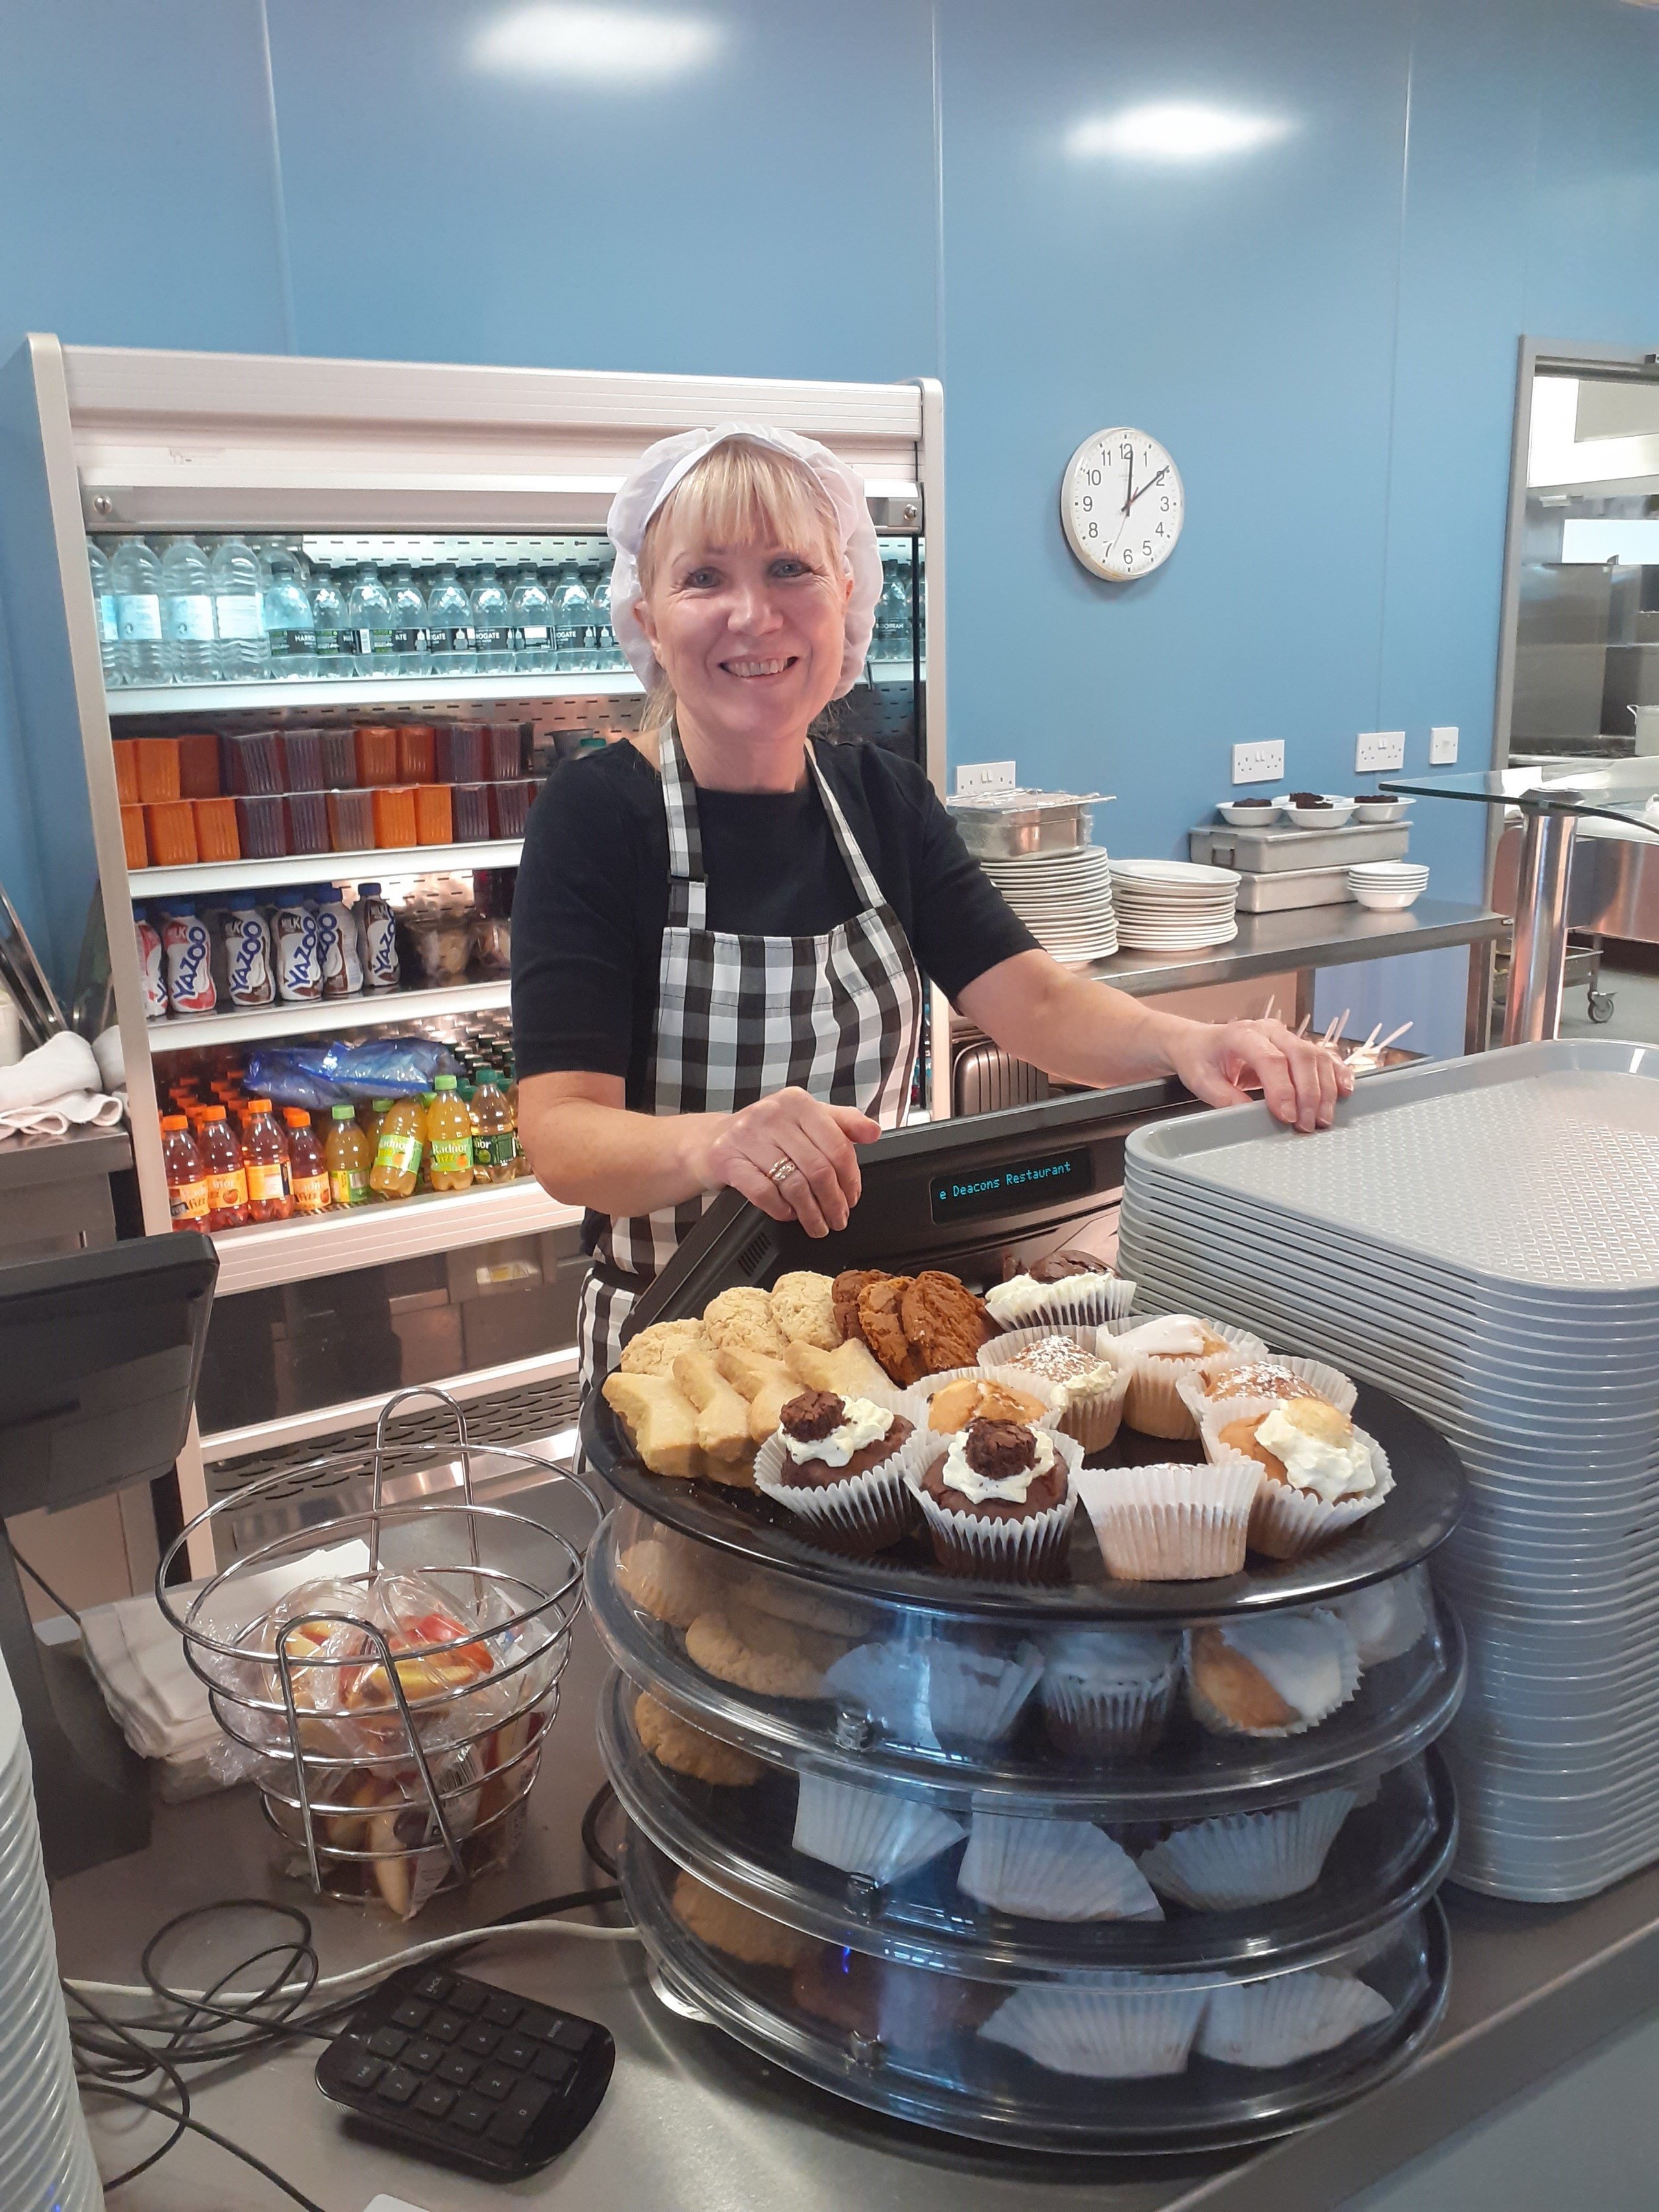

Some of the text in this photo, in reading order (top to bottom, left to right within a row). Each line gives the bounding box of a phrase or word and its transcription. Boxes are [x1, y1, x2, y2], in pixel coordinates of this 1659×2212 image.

[1101, 450, 1111, 466] 11
[1119, 443, 1133, 460] 12
[1143, 451, 1148, 467] 1
[1086, 469, 1102, 486] 10
[1156, 471, 1165, 487] 2
[1083, 496, 1093, 512] 9
[1160, 496, 1170, 511] 3
[1089, 522, 1098, 538] 8
[1155, 522, 1164, 537] 4
[1103, 541, 1113, 557] 7
[1143, 541, 1152, 555] 5
[1123, 549, 1133, 565] 6
[230, 921, 262, 992] YAZOO
[287, 916, 316, 988] YAZOO
[172, 926, 206, 999] YAZOO
[953, 1178, 1001, 1197] Deacons
[1006, 1161, 1071, 1185] Restaurant
